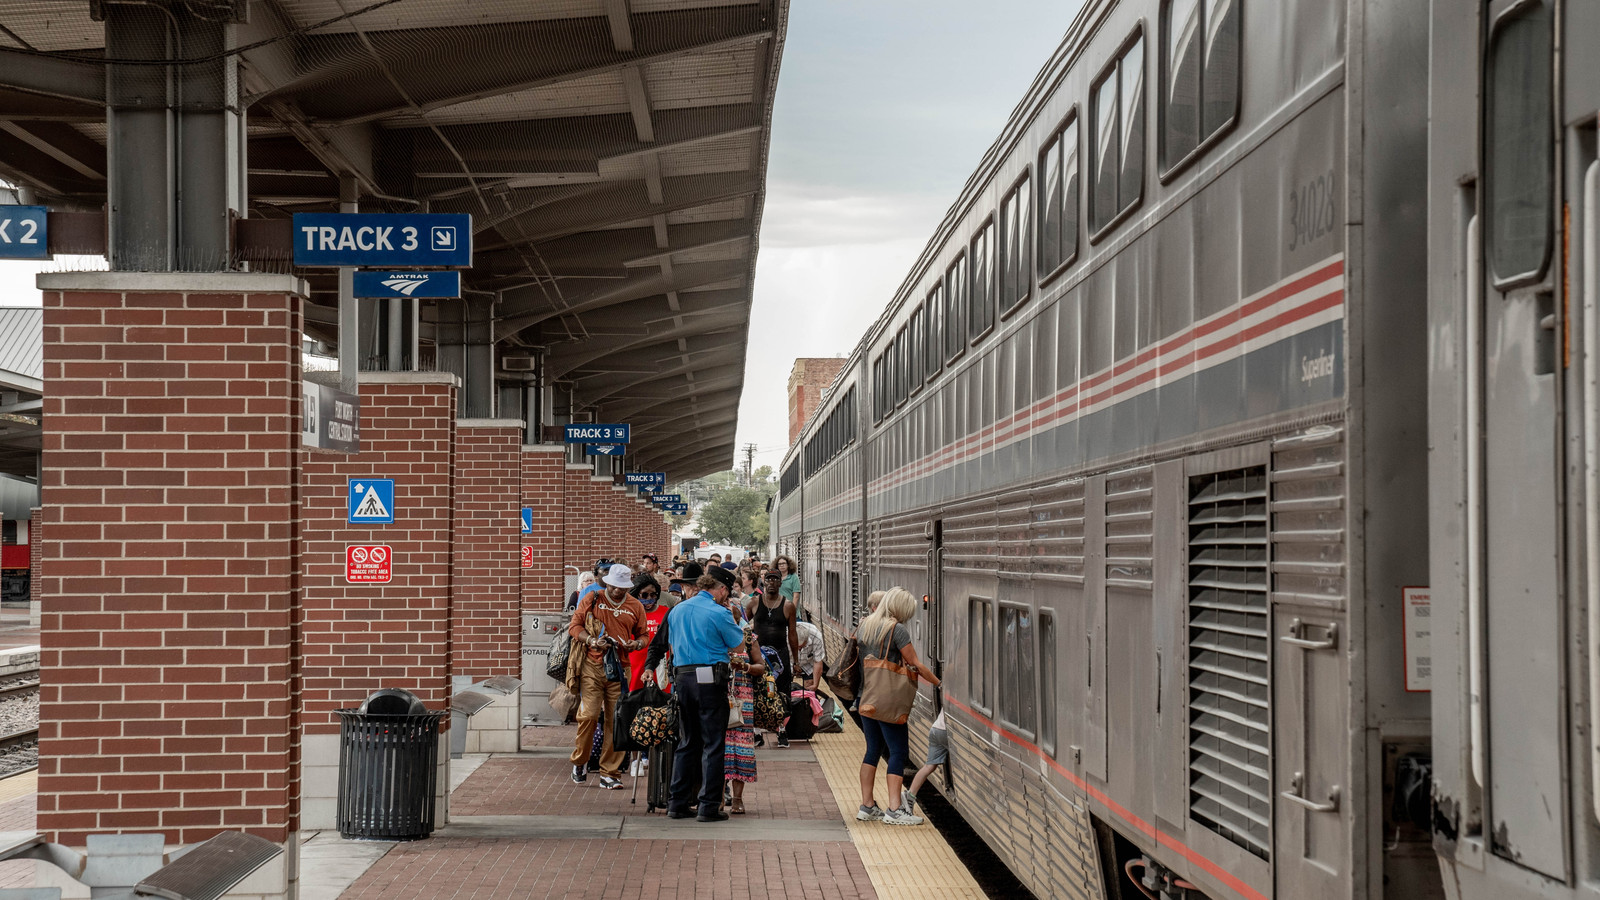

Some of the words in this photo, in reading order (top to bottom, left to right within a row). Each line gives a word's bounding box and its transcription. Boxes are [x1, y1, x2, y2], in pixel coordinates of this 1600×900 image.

[1289, 169, 1335, 251] 34028
[0, 219, 12, 243] K
[20, 219, 38, 244] 2
[301, 226, 394, 251] TRACK
[401, 226, 419, 251] 3
[1301, 349, 1335, 388] Superliner
[567, 428, 602, 438] TRACK
[604, 428, 611, 438] 3
[532, 617, 539, 629] 3
